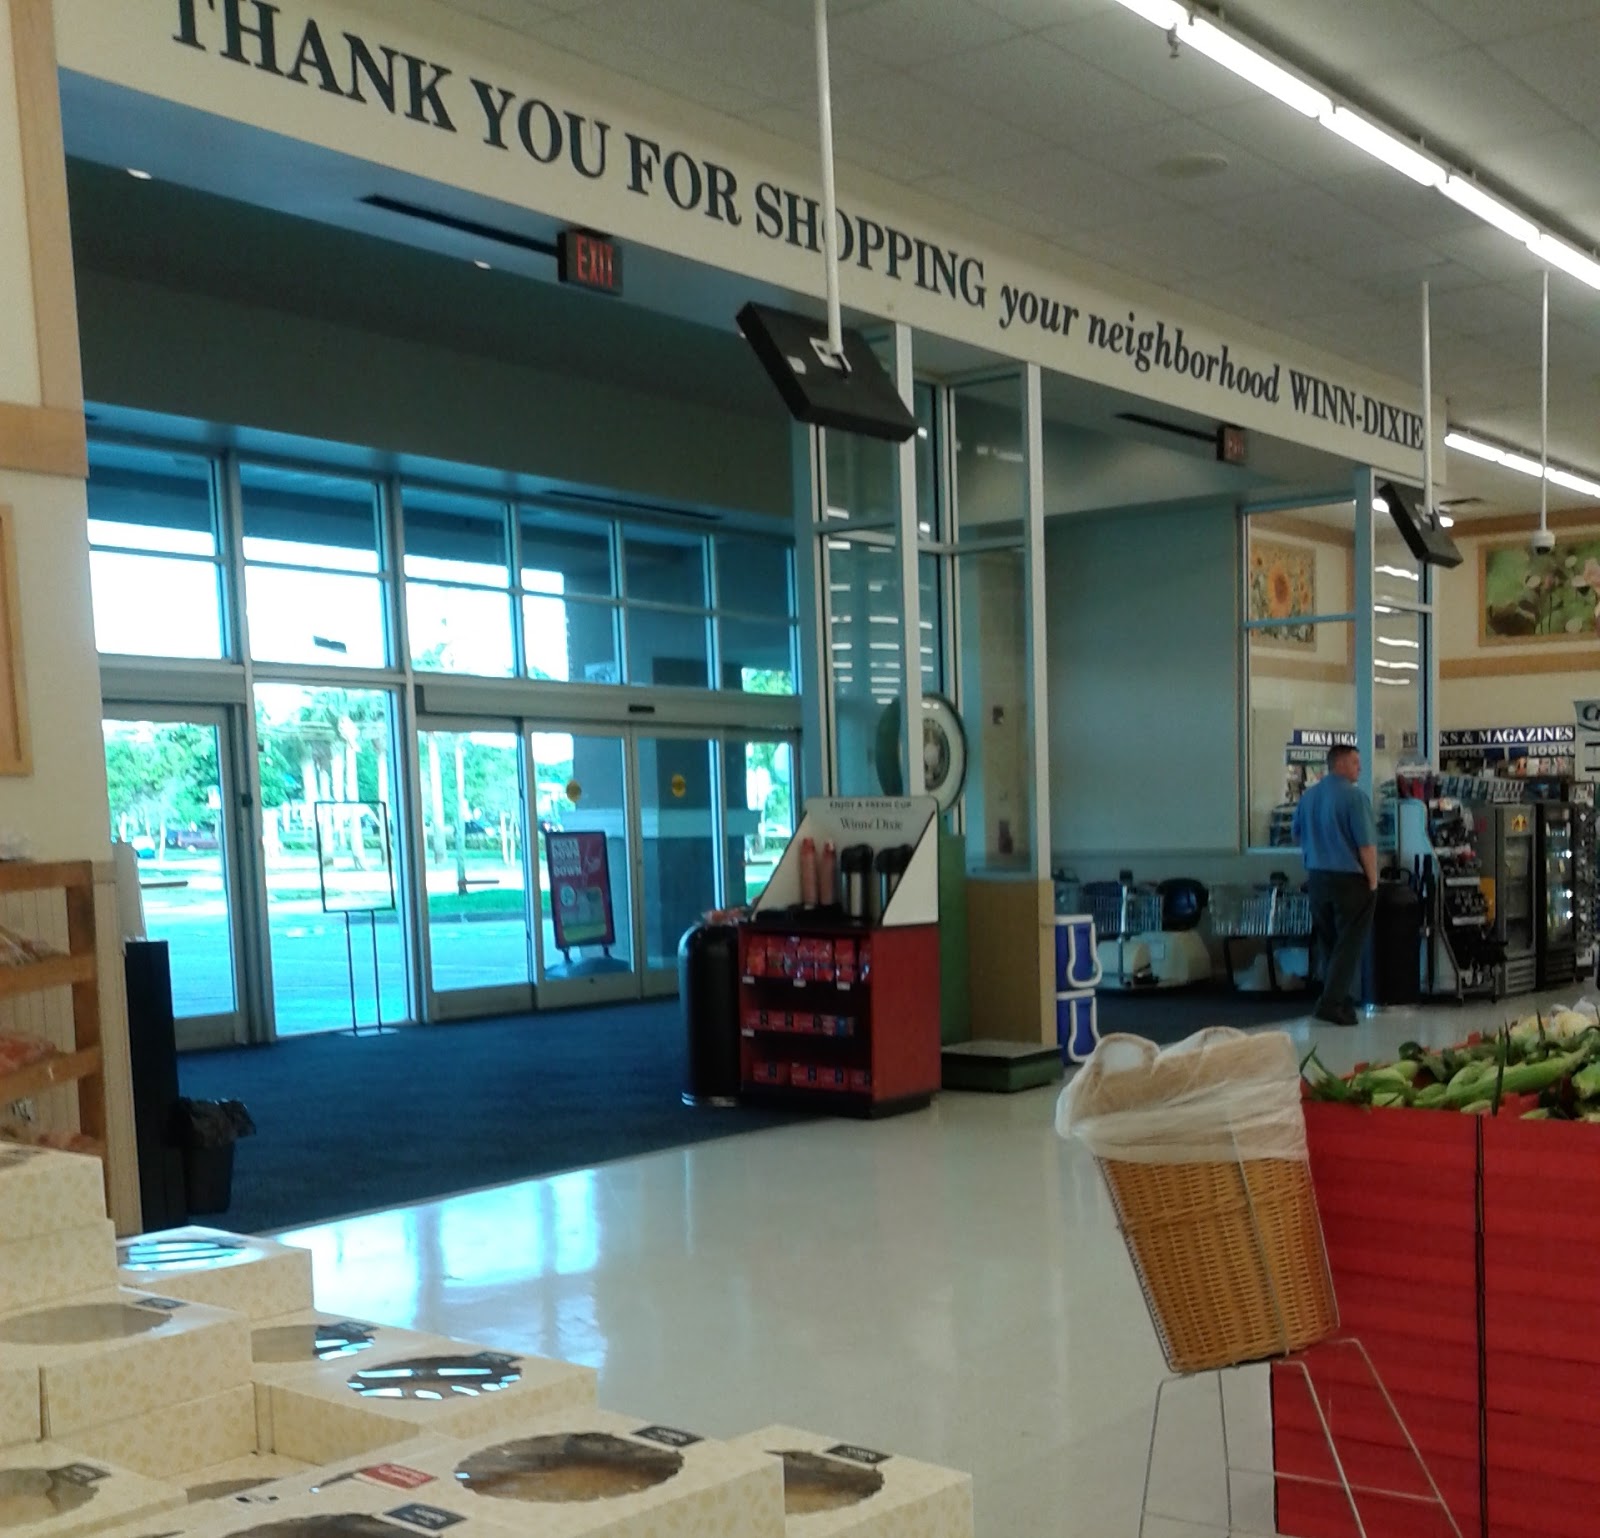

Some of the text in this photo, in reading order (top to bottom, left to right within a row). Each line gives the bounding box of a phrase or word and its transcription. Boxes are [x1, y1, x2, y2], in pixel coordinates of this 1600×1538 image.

[172, 0, 1424, 451] THANK YOU FOR SHOPPING your neighborhood WINN-DIXIE
[1461, 730, 1474, 744] &
[1478, 725, 1574, 744] MAGAZINES
